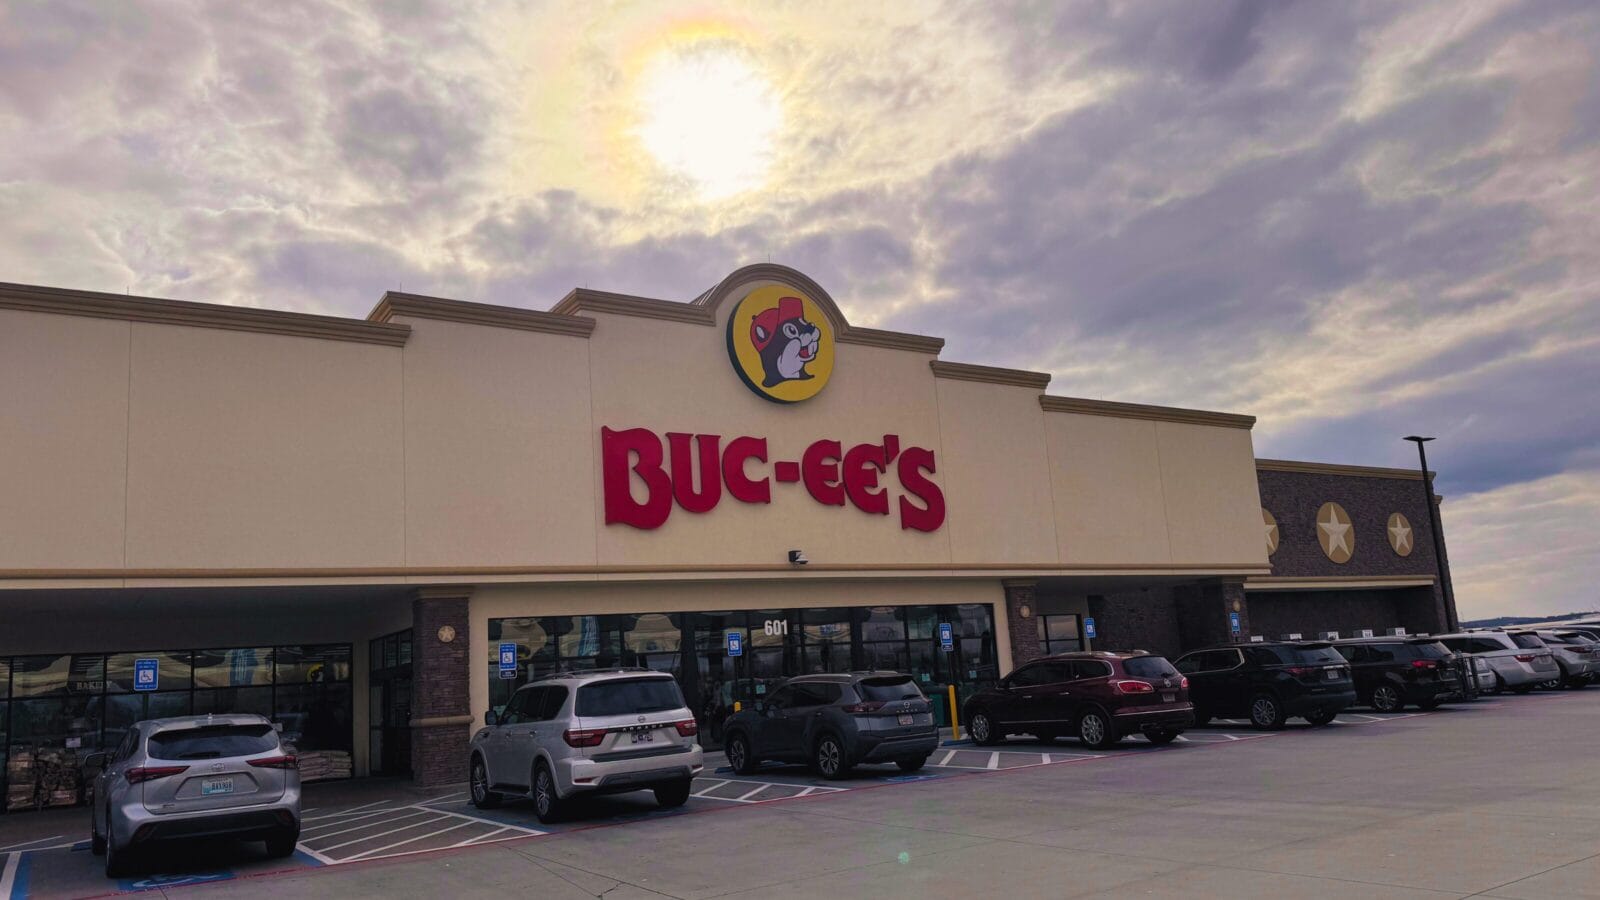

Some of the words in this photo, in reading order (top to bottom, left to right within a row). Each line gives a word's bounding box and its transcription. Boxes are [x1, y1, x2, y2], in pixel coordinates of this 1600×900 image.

[601, 425, 946, 532] BUC-EE'S
[764, 619, 788, 636] 601
[76, 681, 113, 690] BAKEY
